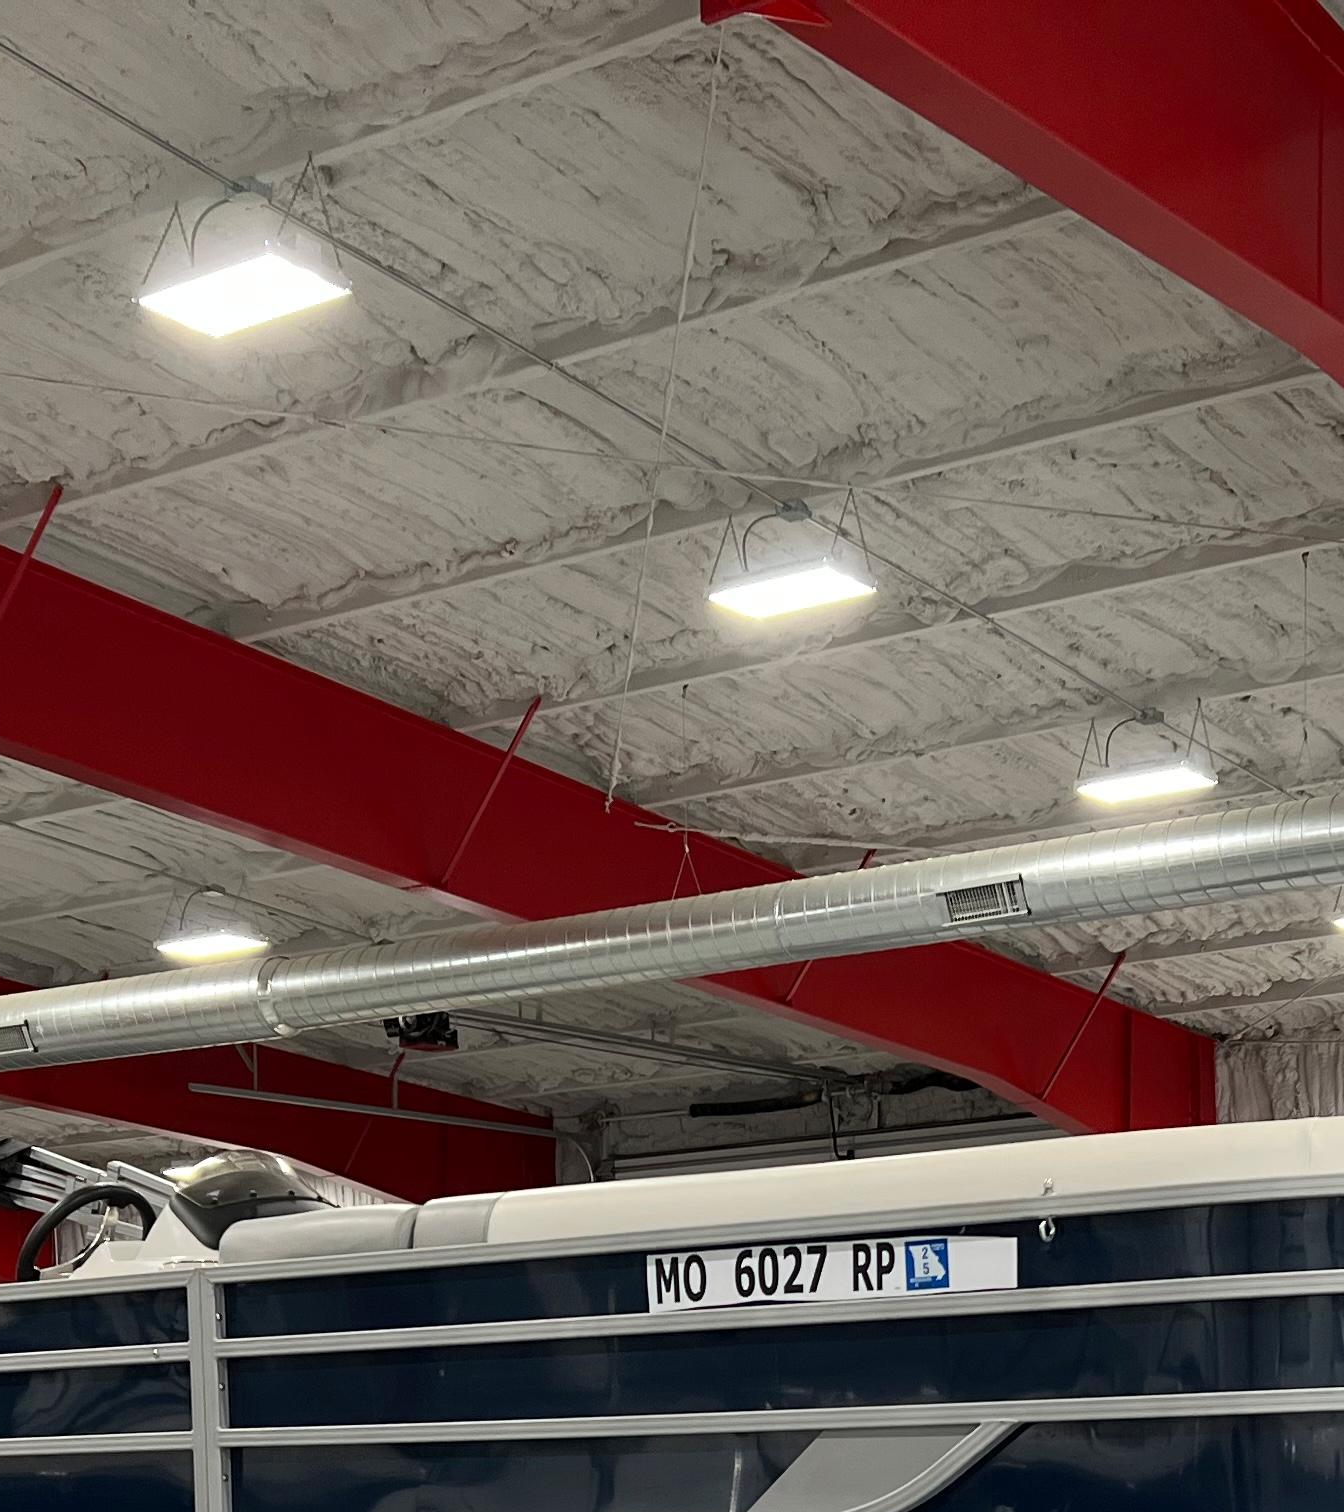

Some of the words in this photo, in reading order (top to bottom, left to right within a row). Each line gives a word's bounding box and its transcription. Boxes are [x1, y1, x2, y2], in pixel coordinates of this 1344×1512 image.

[655, 1253, 707, 1304] MO
[734, 1244, 828, 1298] 6027
[852, 1241, 896, 1292] RP
